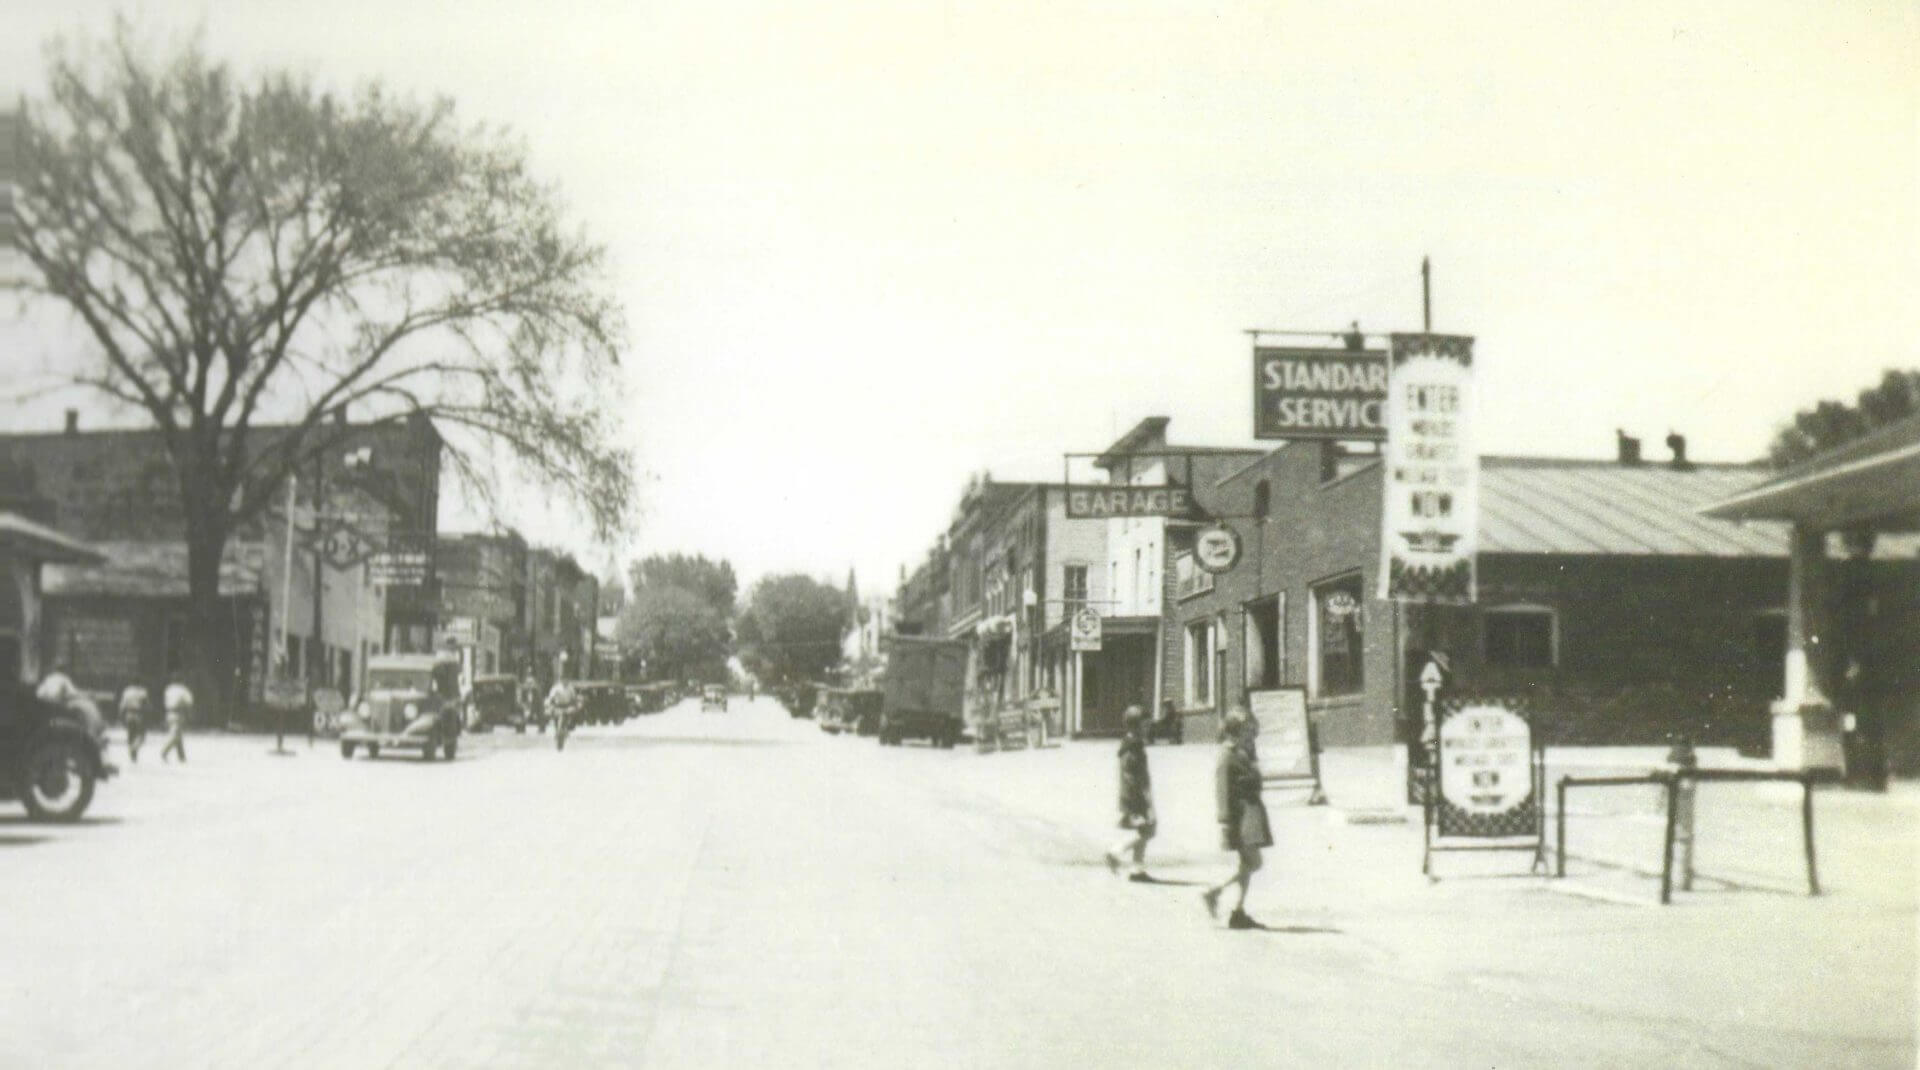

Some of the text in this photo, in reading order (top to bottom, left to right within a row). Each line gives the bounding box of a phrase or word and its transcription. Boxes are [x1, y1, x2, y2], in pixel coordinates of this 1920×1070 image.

[1264, 360, 1386, 392] STANDAR
[1278, 398, 1385, 428] SERVIC
[1069, 490, 1189, 513] GARAGE
